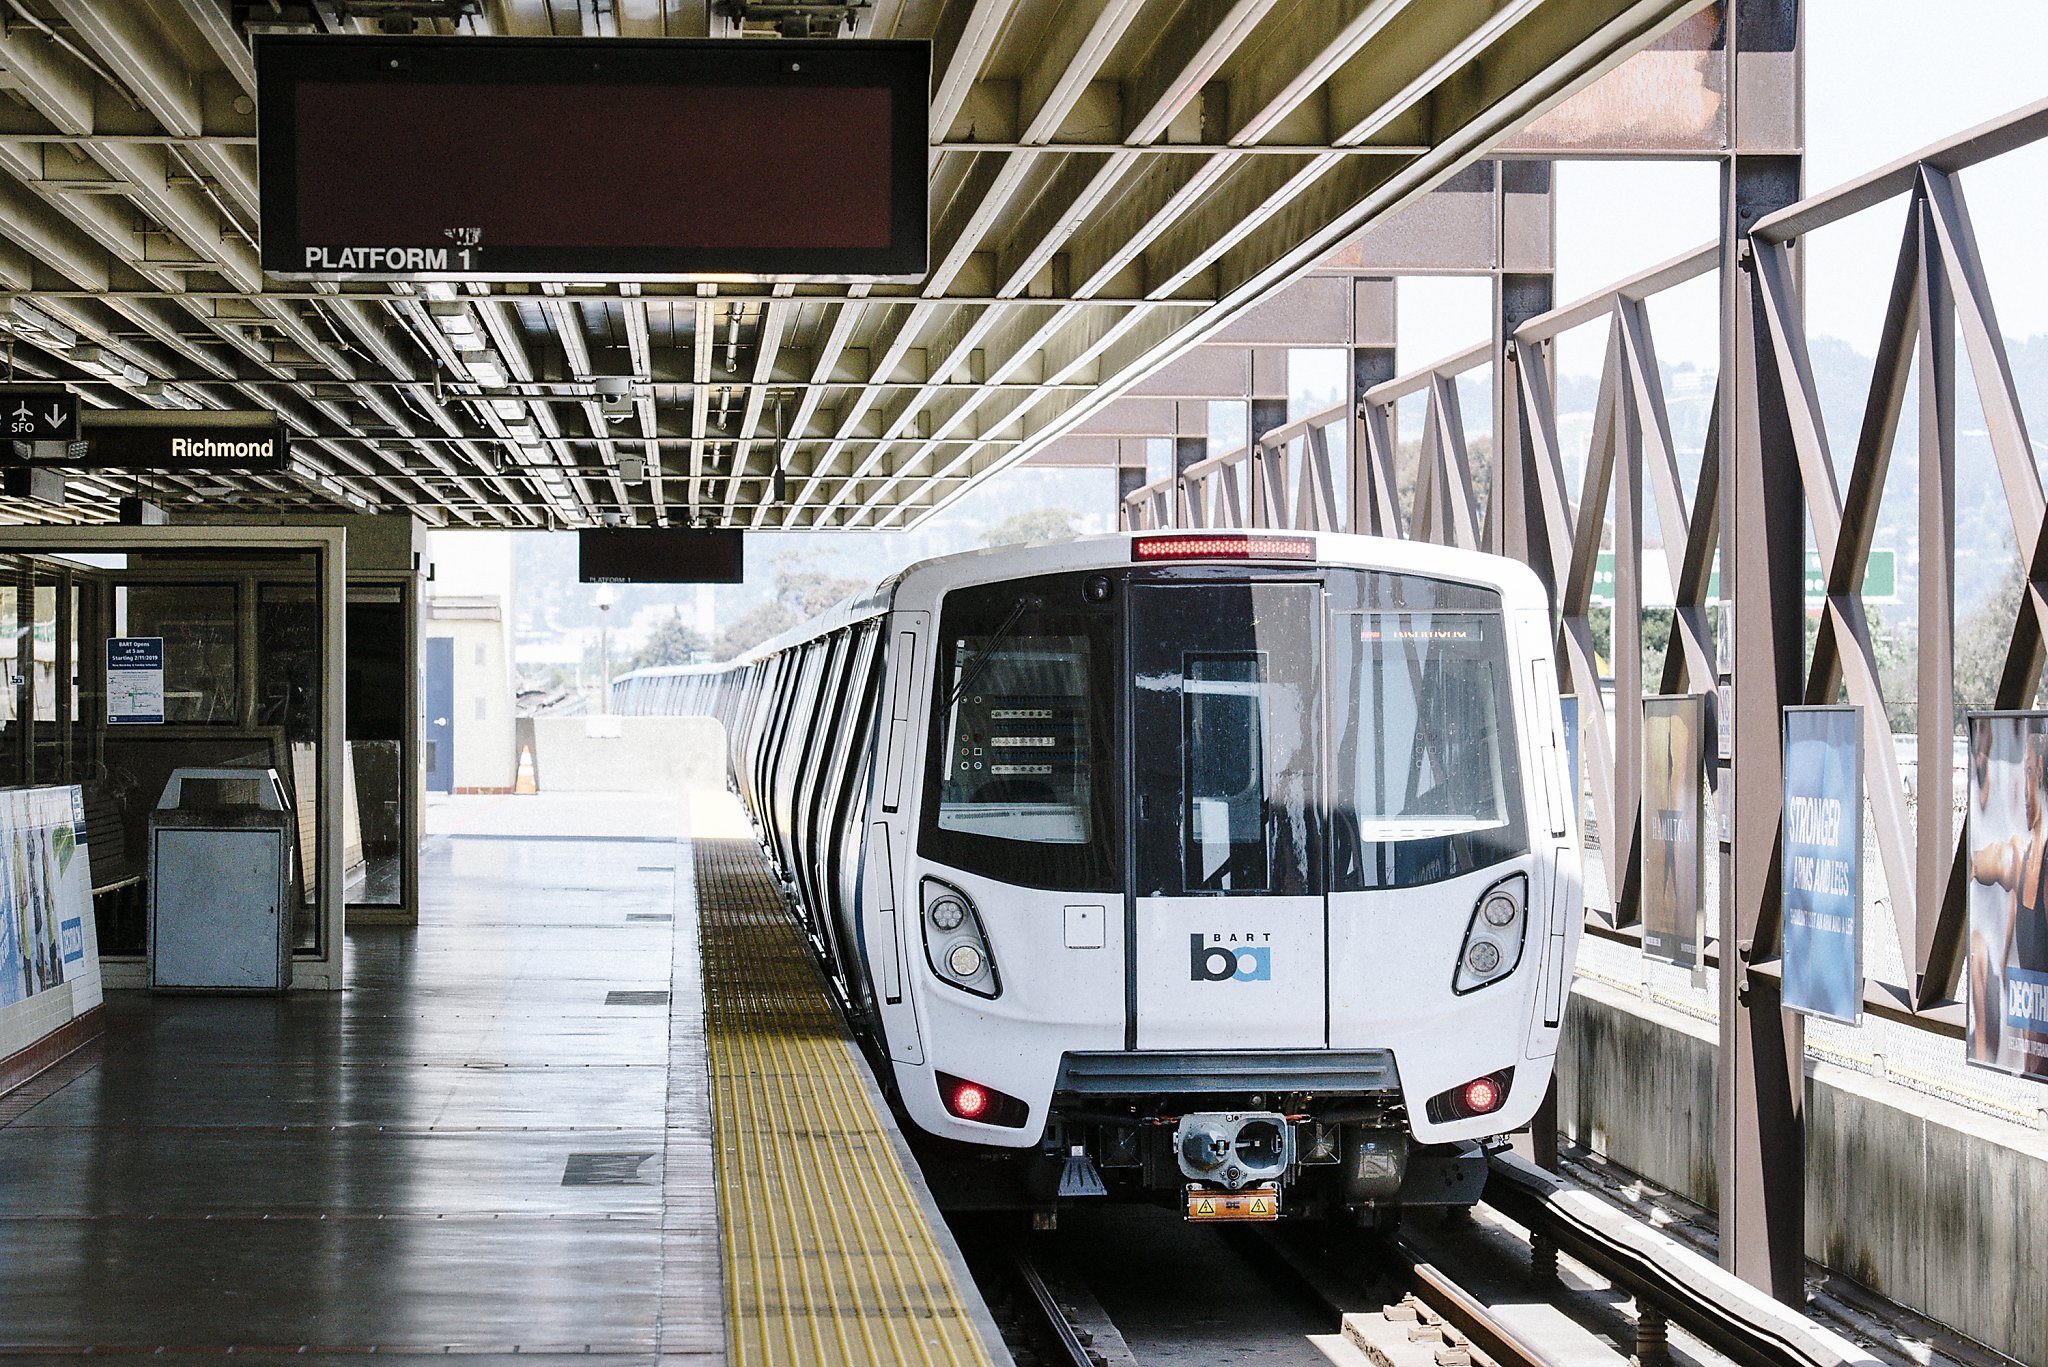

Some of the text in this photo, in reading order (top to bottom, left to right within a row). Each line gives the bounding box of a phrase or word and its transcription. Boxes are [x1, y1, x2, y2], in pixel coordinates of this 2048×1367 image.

[305, 246, 470, 271] PLATFORM 1
[11, 422, 35, 433] SFO
[171, 438, 274, 458] Richmond
[1652, 816, 1690, 843] HAMILTON
[1789, 796, 1841, 848] STRONGER
[1793, 856, 1849, 897] ARMS AND LEGS
[1213, 933, 1271, 942] BART
